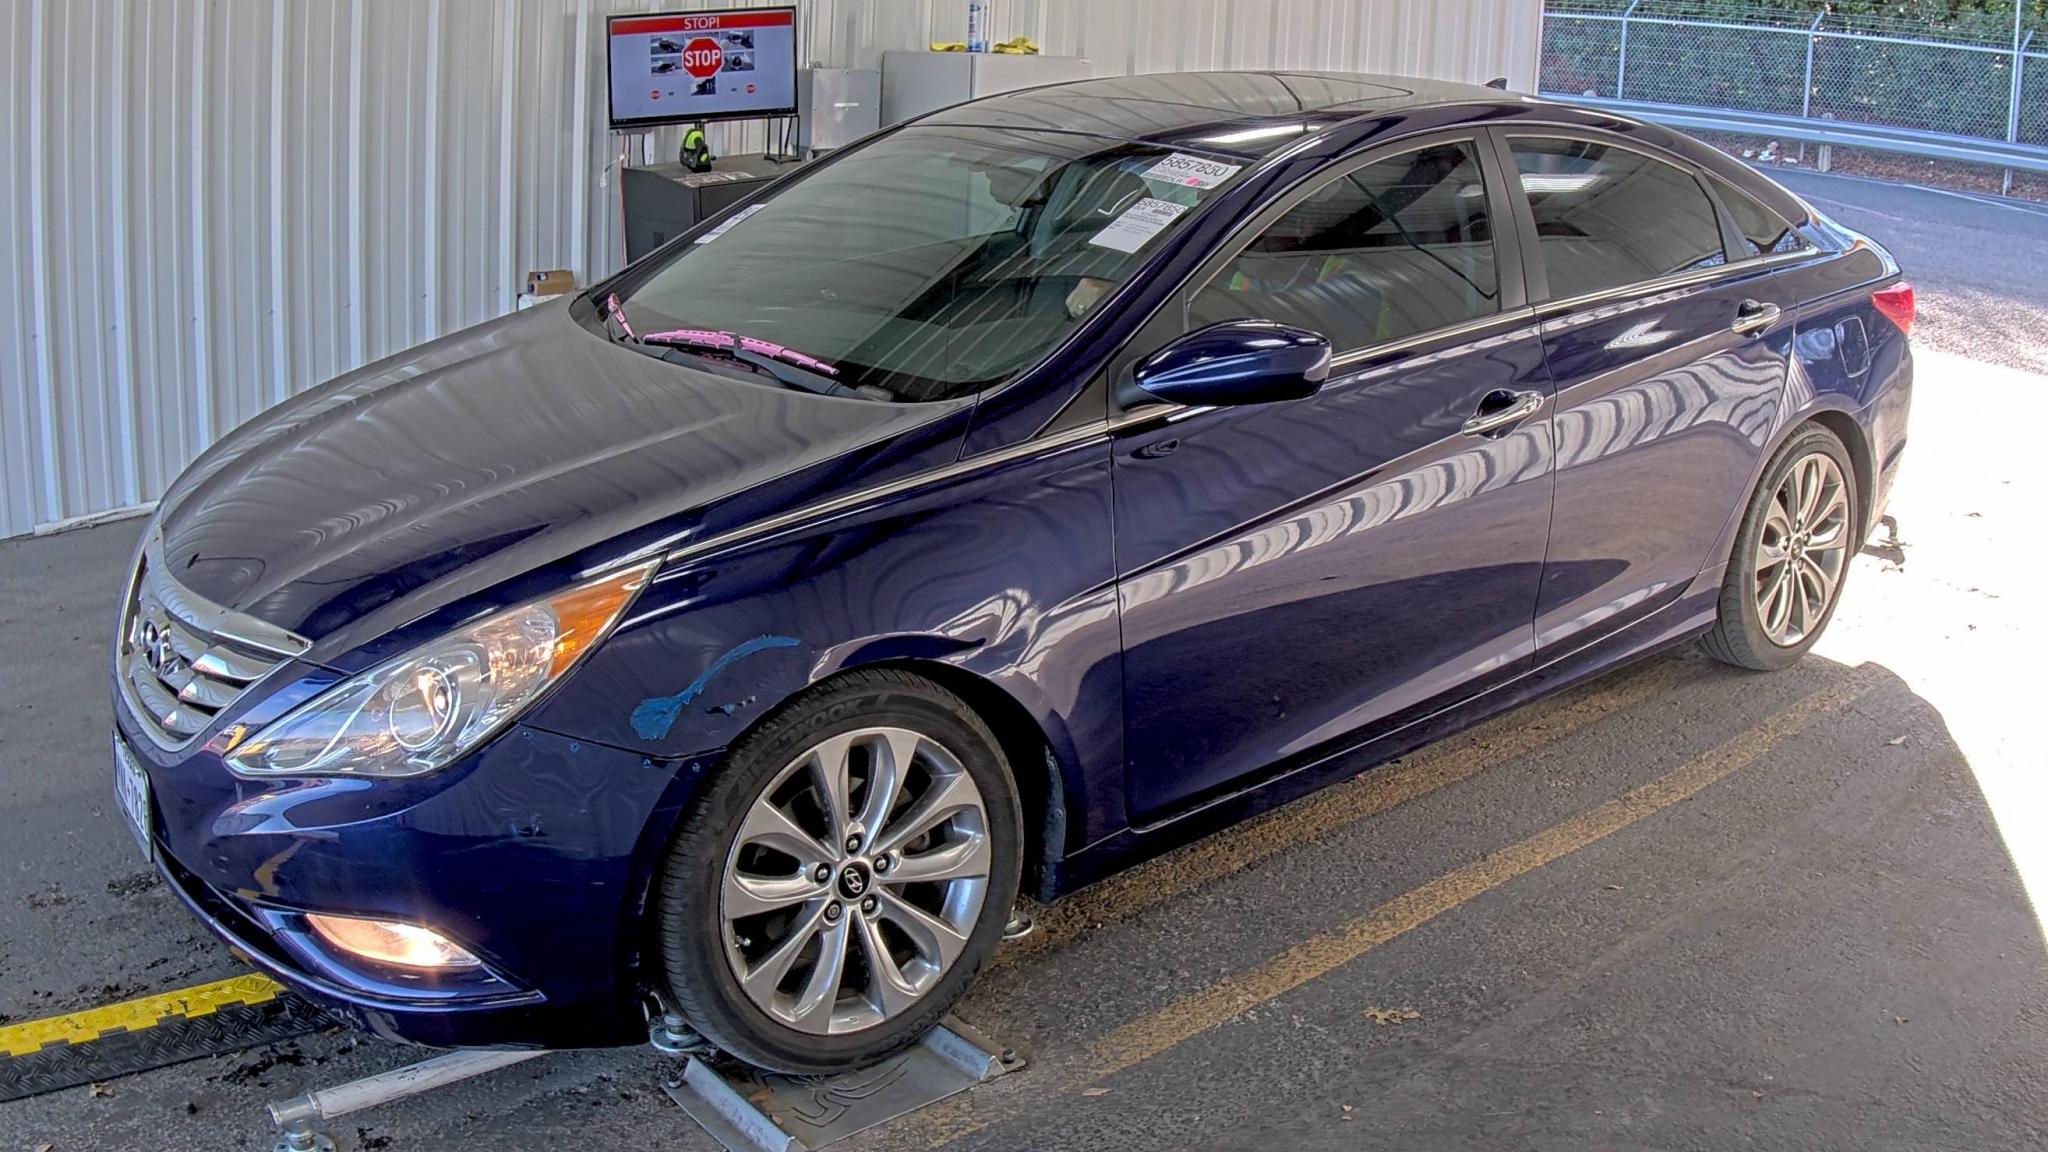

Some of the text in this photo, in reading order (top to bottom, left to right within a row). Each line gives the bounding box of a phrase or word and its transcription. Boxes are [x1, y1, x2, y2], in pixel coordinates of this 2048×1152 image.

[684, 16, 720, 30] STOP!
[684, 49, 721, 67] STOP
[1160, 156, 1229, 176] 5857850
